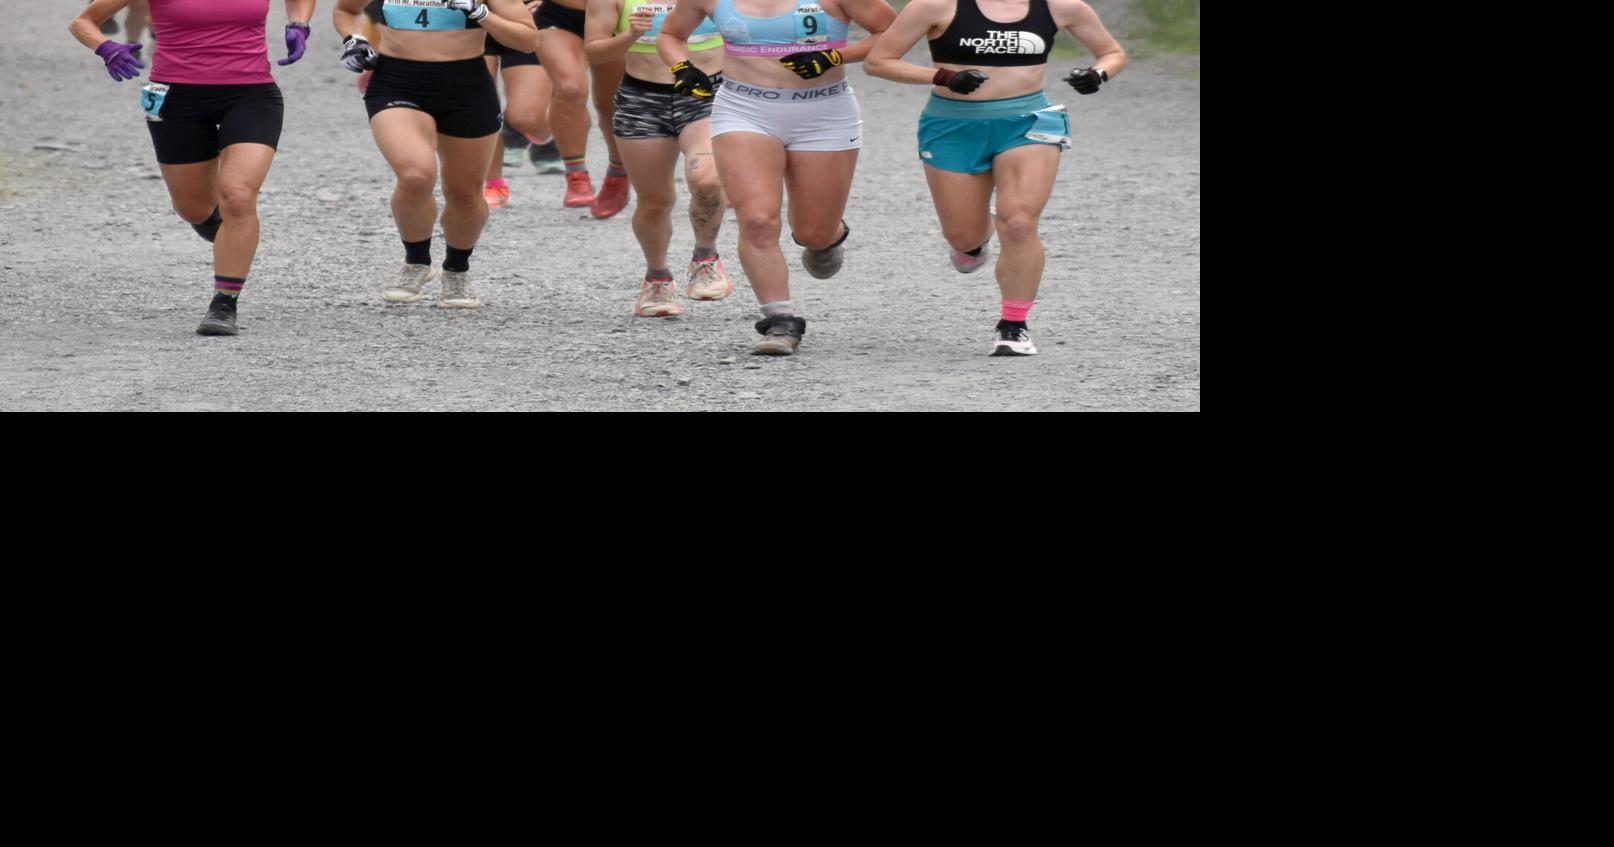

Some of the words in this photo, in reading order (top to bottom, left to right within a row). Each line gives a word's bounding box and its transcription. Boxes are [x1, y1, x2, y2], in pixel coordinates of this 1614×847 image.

[415, 8, 429, 28] 4
[802, 15, 818, 36] 9
[959, 38, 1018, 47] NORTH
[987, 30, 1018, 39] THE
[975, 46, 1018, 54] FACE
[735, 85, 780, 100] PRO
[791, 85, 840, 101] NIKE
[145, 93, 156, 111] 5
